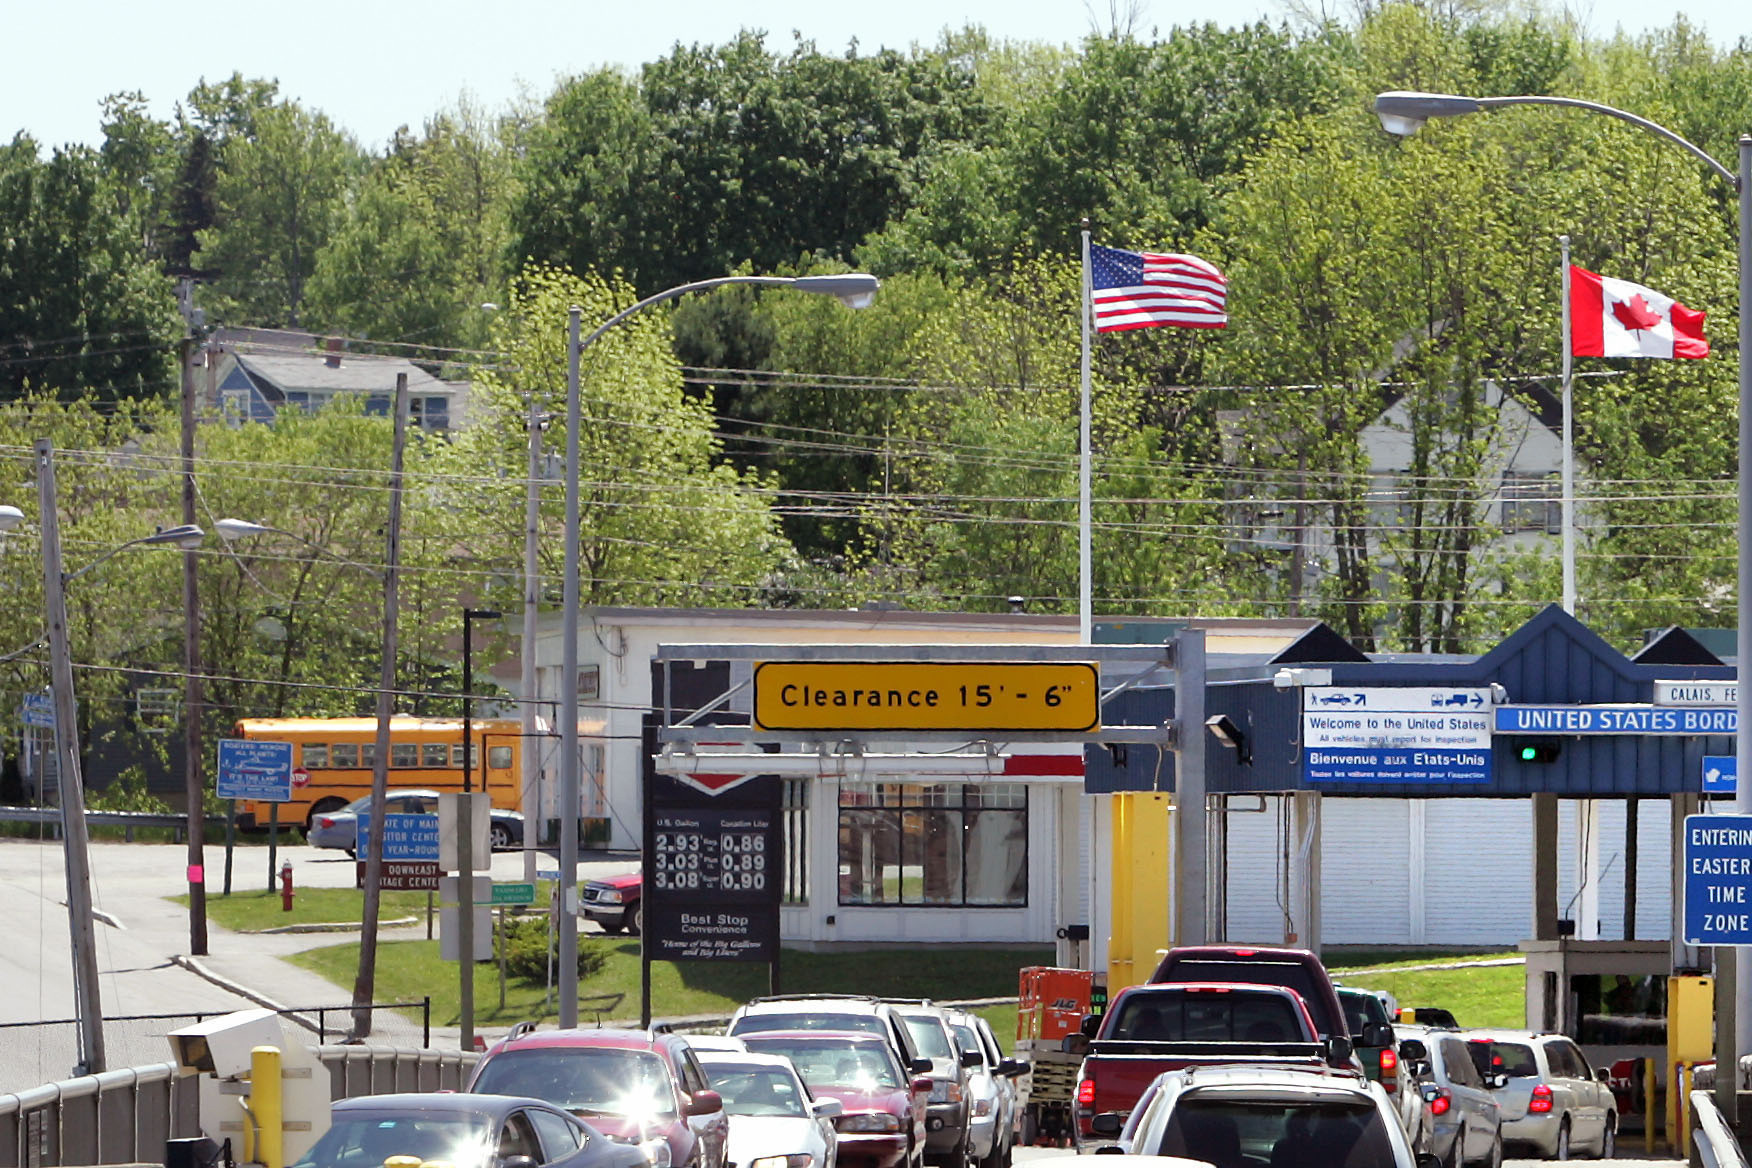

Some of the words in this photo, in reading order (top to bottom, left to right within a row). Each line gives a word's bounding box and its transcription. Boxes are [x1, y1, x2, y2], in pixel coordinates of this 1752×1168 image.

[780, 684, 940, 707] Clearance
[1671, 687, 1715, 702] CALAIS,
[1309, 717, 1362, 730] Welcome
[1366, 717, 1379, 730] to
[1383, 717, 1403, 730] the
[1407, 718, 1445, 730] United
[1449, 718, 1487, 730] States
[1517, 710, 1593, 729] UNITED
[1599, 711, 1677, 730] STATES
[1332, 734, 1366, 744] vehicles
[1391, 735, 1417, 745] report
[1420, 735, 1432, 744] for
[1435, 735, 1478, 745] inspection
[1309, 752, 1378, 766] Bienvenue
[1383, 755, 1408, 766] aux
[402, 818, 415, 829] OF
[419, 818, 440, 829] MAIN
[412, 831, 440, 842] CENTE
[655, 833, 700, 852] 2.93
[722, 834, 766, 853] 0.86
[387, 845, 440, 855] YEAR-ROUN
[655, 852, 699, 871] 3.03
[722, 853, 766, 872] 0.89
[388, 865, 437, 875] DOWNEAST
[408, 877, 440, 888] CENTE
[655, 871, 699, 889] 3.08
[722, 872, 766, 890] 0.90
[1707, 885, 1746, 904] TIME
[680, 913, 711, 925] Best
[717, 914, 749, 927] Stop
[1703, 914, 1749, 931] ZONE
[680, 925, 748, 935] Convenience
[1050, 998, 1077, 1009] JLG
